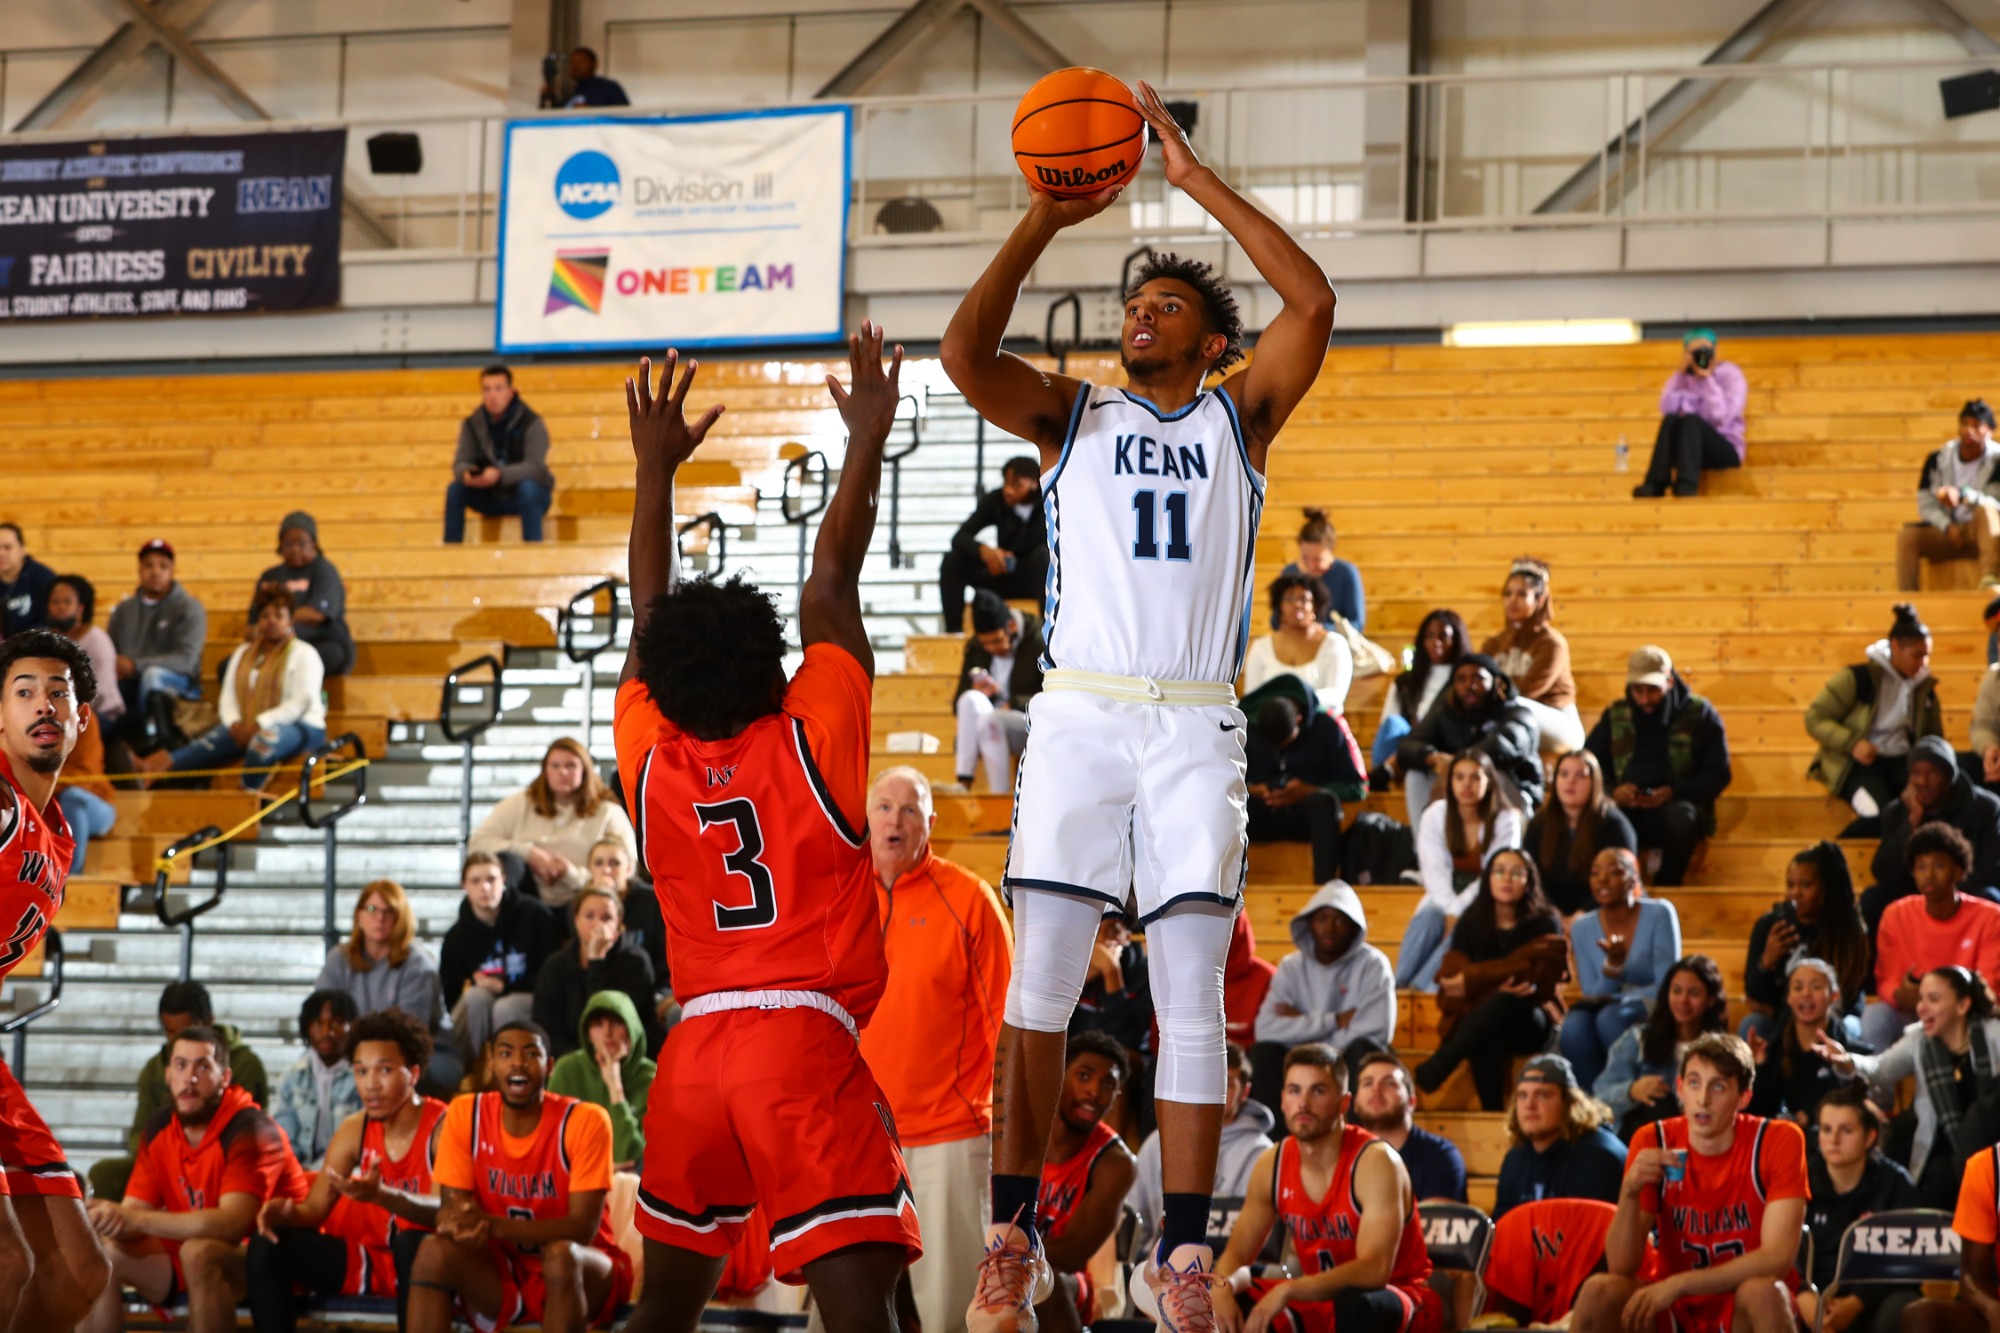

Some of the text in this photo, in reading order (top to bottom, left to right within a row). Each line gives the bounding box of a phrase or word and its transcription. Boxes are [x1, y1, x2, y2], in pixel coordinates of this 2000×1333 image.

[633, 174, 744, 206] Division
[1034, 159, 1128, 187] Wilson
[58, 187, 215, 223] UNIVERSITY
[236, 176, 332, 214] KEAN
[559, 182, 620, 205] NCAA
[29, 250, 166, 286] FAIRNESS
[186, 245, 313, 280] CIVILITY
[616, 263, 794, 296] ONETEAM
[1114, 433, 1210, 481] KEAN
[1131, 488, 1193, 563] 11
[18, 850, 67, 904] WILL
[692, 796, 778, 931] 3
[1853, 1226, 1962, 1256] KEAN
